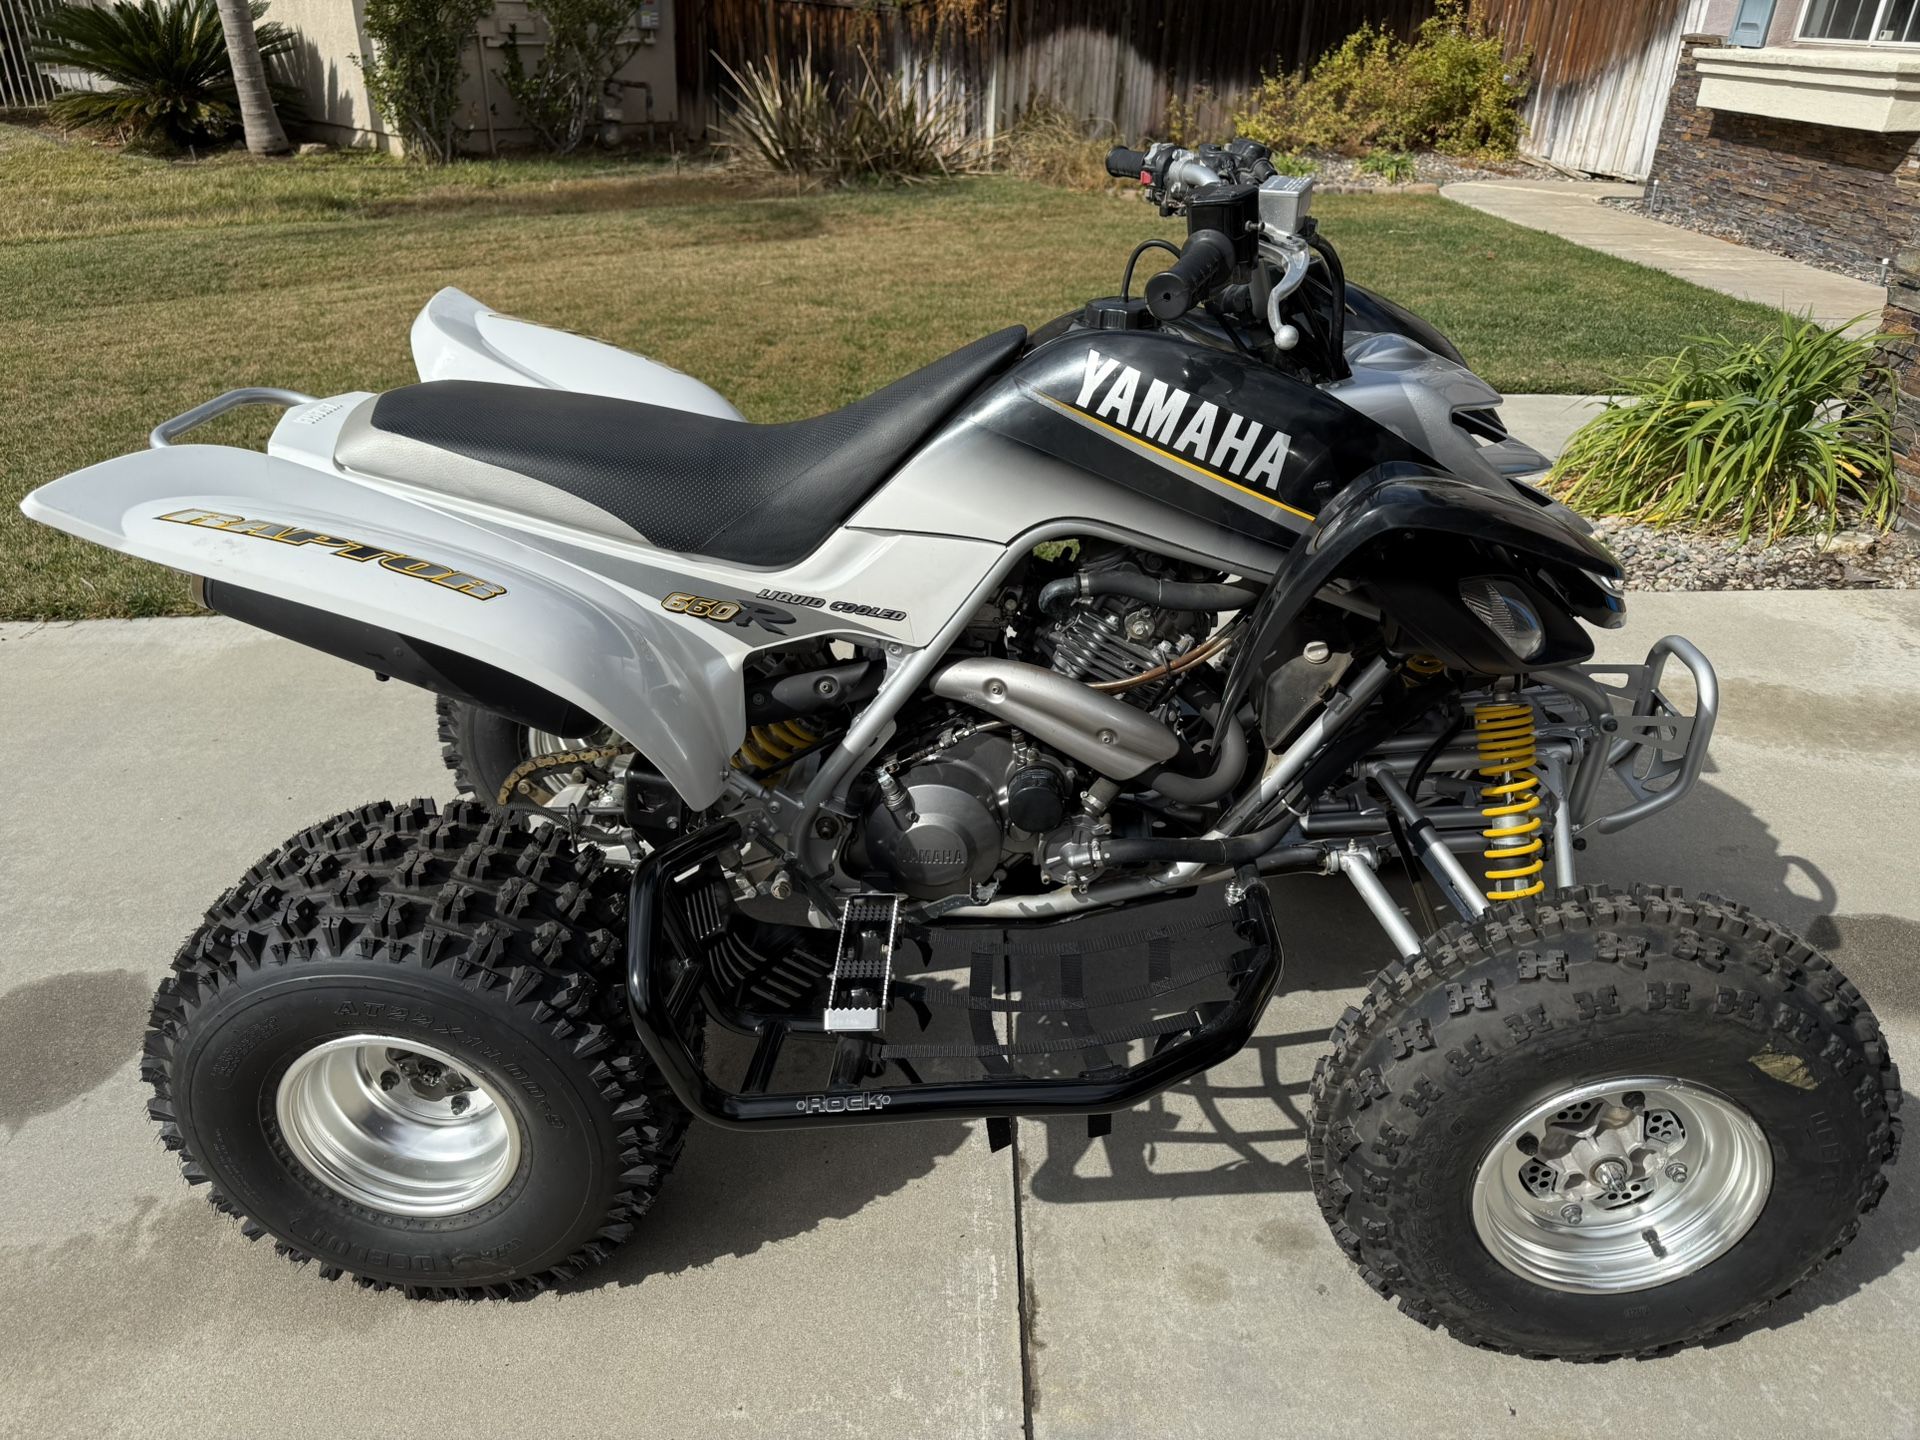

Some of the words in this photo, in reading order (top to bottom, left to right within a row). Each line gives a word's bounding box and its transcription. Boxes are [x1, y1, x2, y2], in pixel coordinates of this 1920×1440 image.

[1075, 349, 1292, 491] YAMAHA
[154, 508, 508, 600] RAPTOR
[756, 588, 826, 608] LIQUID
[829, 600, 907, 621] COOLED
[902, 848, 965, 865] YAMAHA
